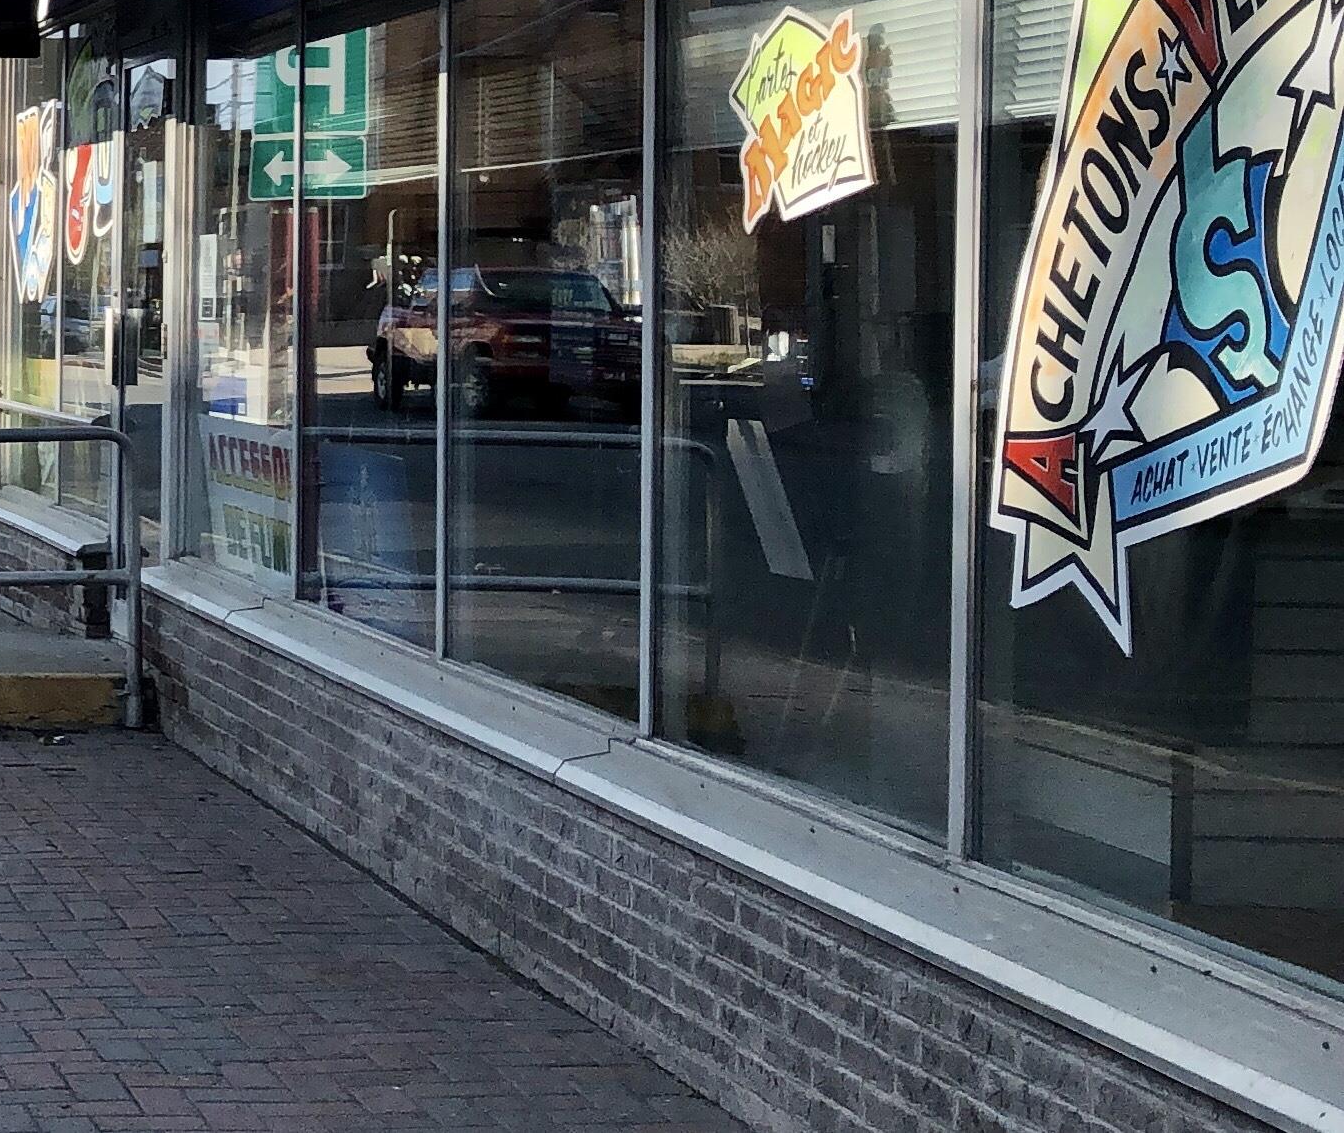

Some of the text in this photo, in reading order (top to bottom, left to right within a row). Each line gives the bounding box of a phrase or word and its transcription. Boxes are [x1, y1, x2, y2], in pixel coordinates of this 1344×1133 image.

[744, 19, 858, 223] MAGIC
[791, 122, 857, 192] hockey
[808, 112, 824, 144] et
[1004, 50, 1170, 516] ACHETONS
[1130, 449, 1190, 506] ACHAT
[1196, 421, 1253, 479] VENTE
[1261, 299, 1325, 454] ÉCHANGE
